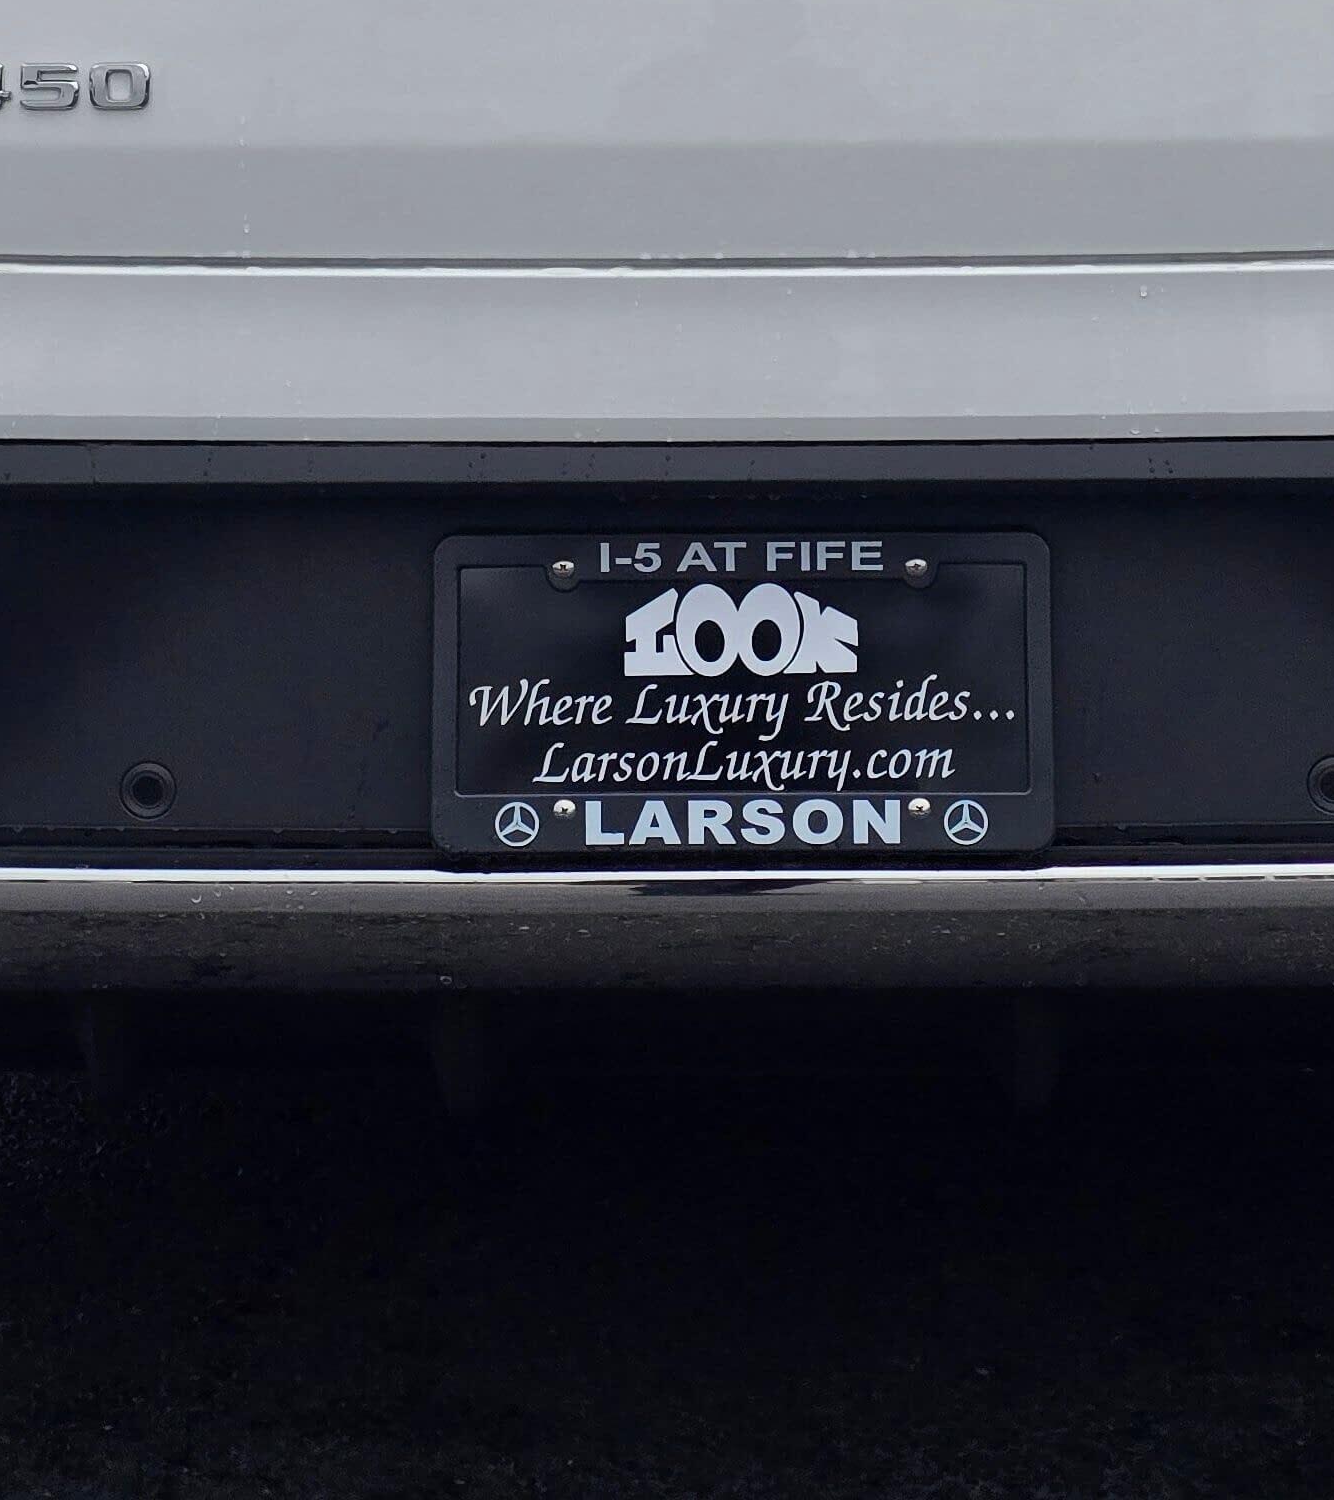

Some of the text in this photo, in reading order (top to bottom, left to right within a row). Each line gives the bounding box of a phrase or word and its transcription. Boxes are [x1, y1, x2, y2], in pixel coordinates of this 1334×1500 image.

[600, 540, 884, 573] I-5 AT FIFE
[624, 582, 859, 677] LOOK
[468, 674, 1016, 741] Where Luxury Resides...
[532, 741, 956, 792] LarsonLuxury.com
[584, 799, 901, 846] LARSON
